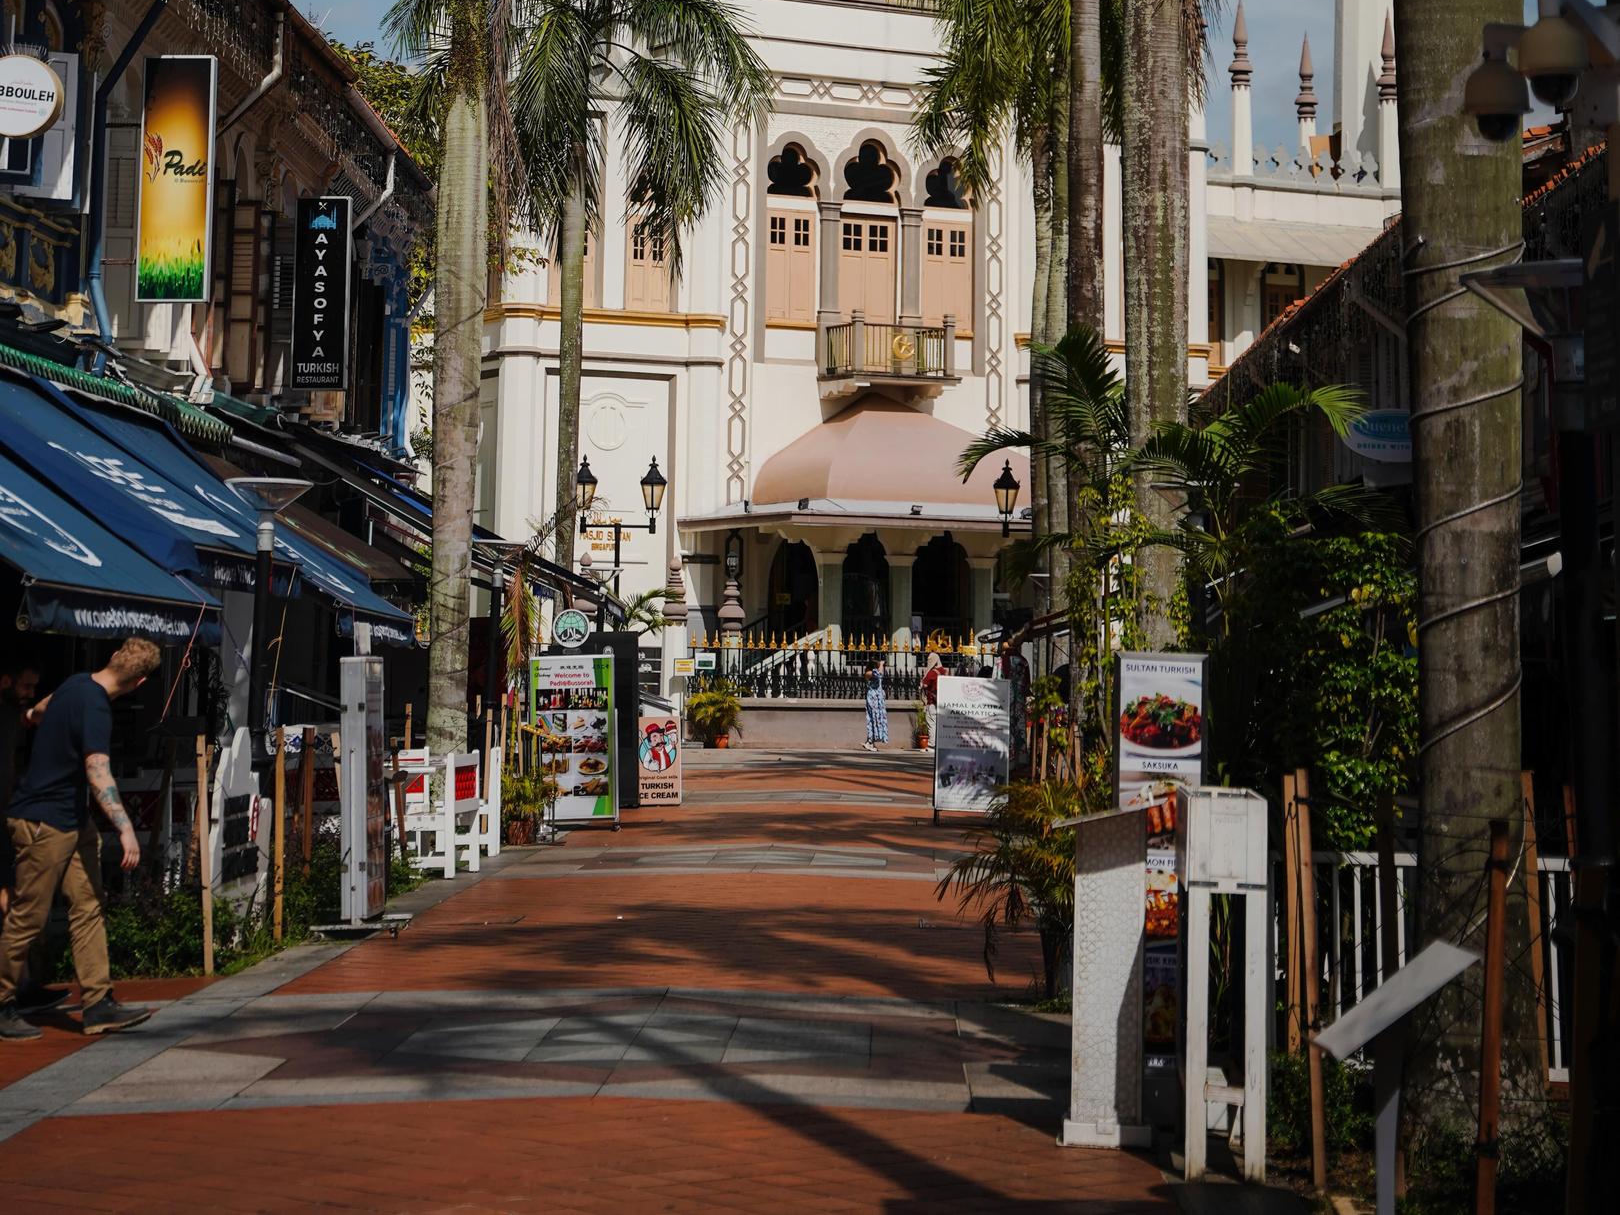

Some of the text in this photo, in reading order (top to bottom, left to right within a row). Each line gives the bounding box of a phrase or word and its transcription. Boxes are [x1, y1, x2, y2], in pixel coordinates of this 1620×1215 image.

[163, 150, 207, 177] Padi
[312, 233, 329, 357] AYASOFYA
[297, 363, 340, 374] TURKISH
[296, 375, 340, 384] RESTAURANT
[1125, 664, 1196, 675] SULTAN TURKISH
[1142, 761, 1179, 771] SAKSUKA
[641, 782, 674, 790] TURKISH
[651, 791, 679, 799] CREAM
